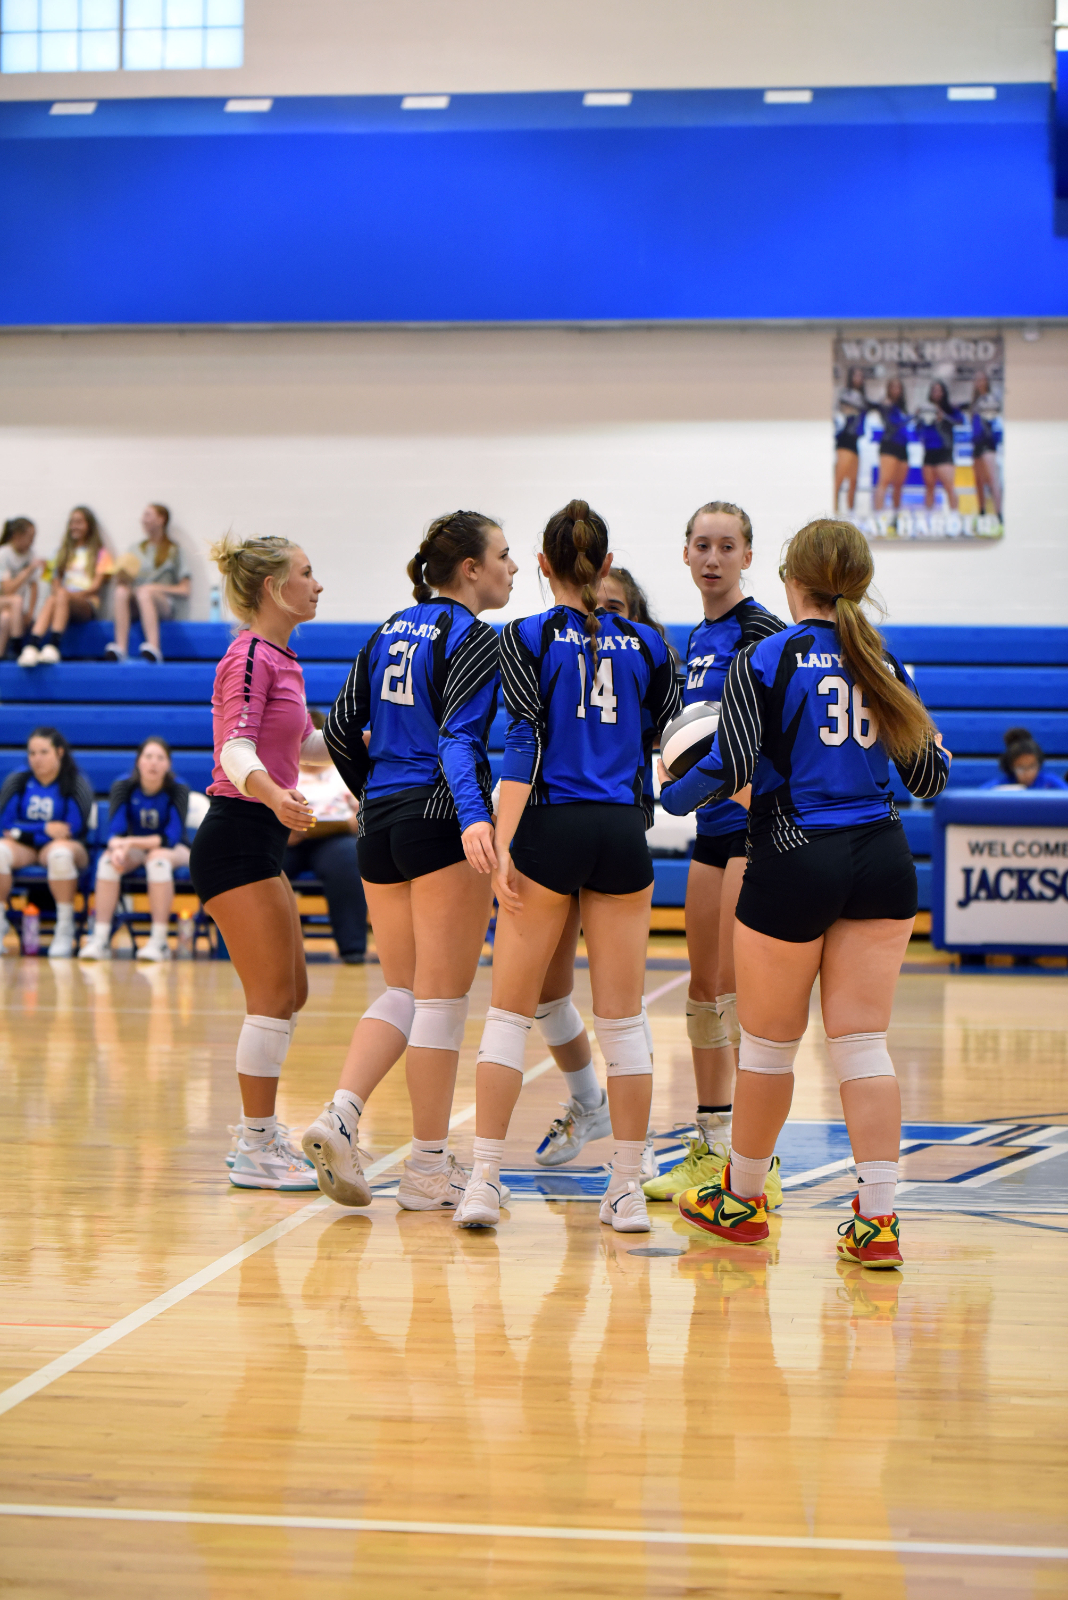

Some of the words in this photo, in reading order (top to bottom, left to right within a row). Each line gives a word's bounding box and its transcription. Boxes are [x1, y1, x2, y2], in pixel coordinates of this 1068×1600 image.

[841, 340, 918, 362] WORK
[923, 338, 996, 361] HARD
[380, 640, 418, 706] 21
[687, 654, 715, 690] 27
[795, 652, 844, 669] LADY
[576, 652, 617, 724] 14
[817, 675, 880, 750] 36
[26, 795, 54, 821] 29
